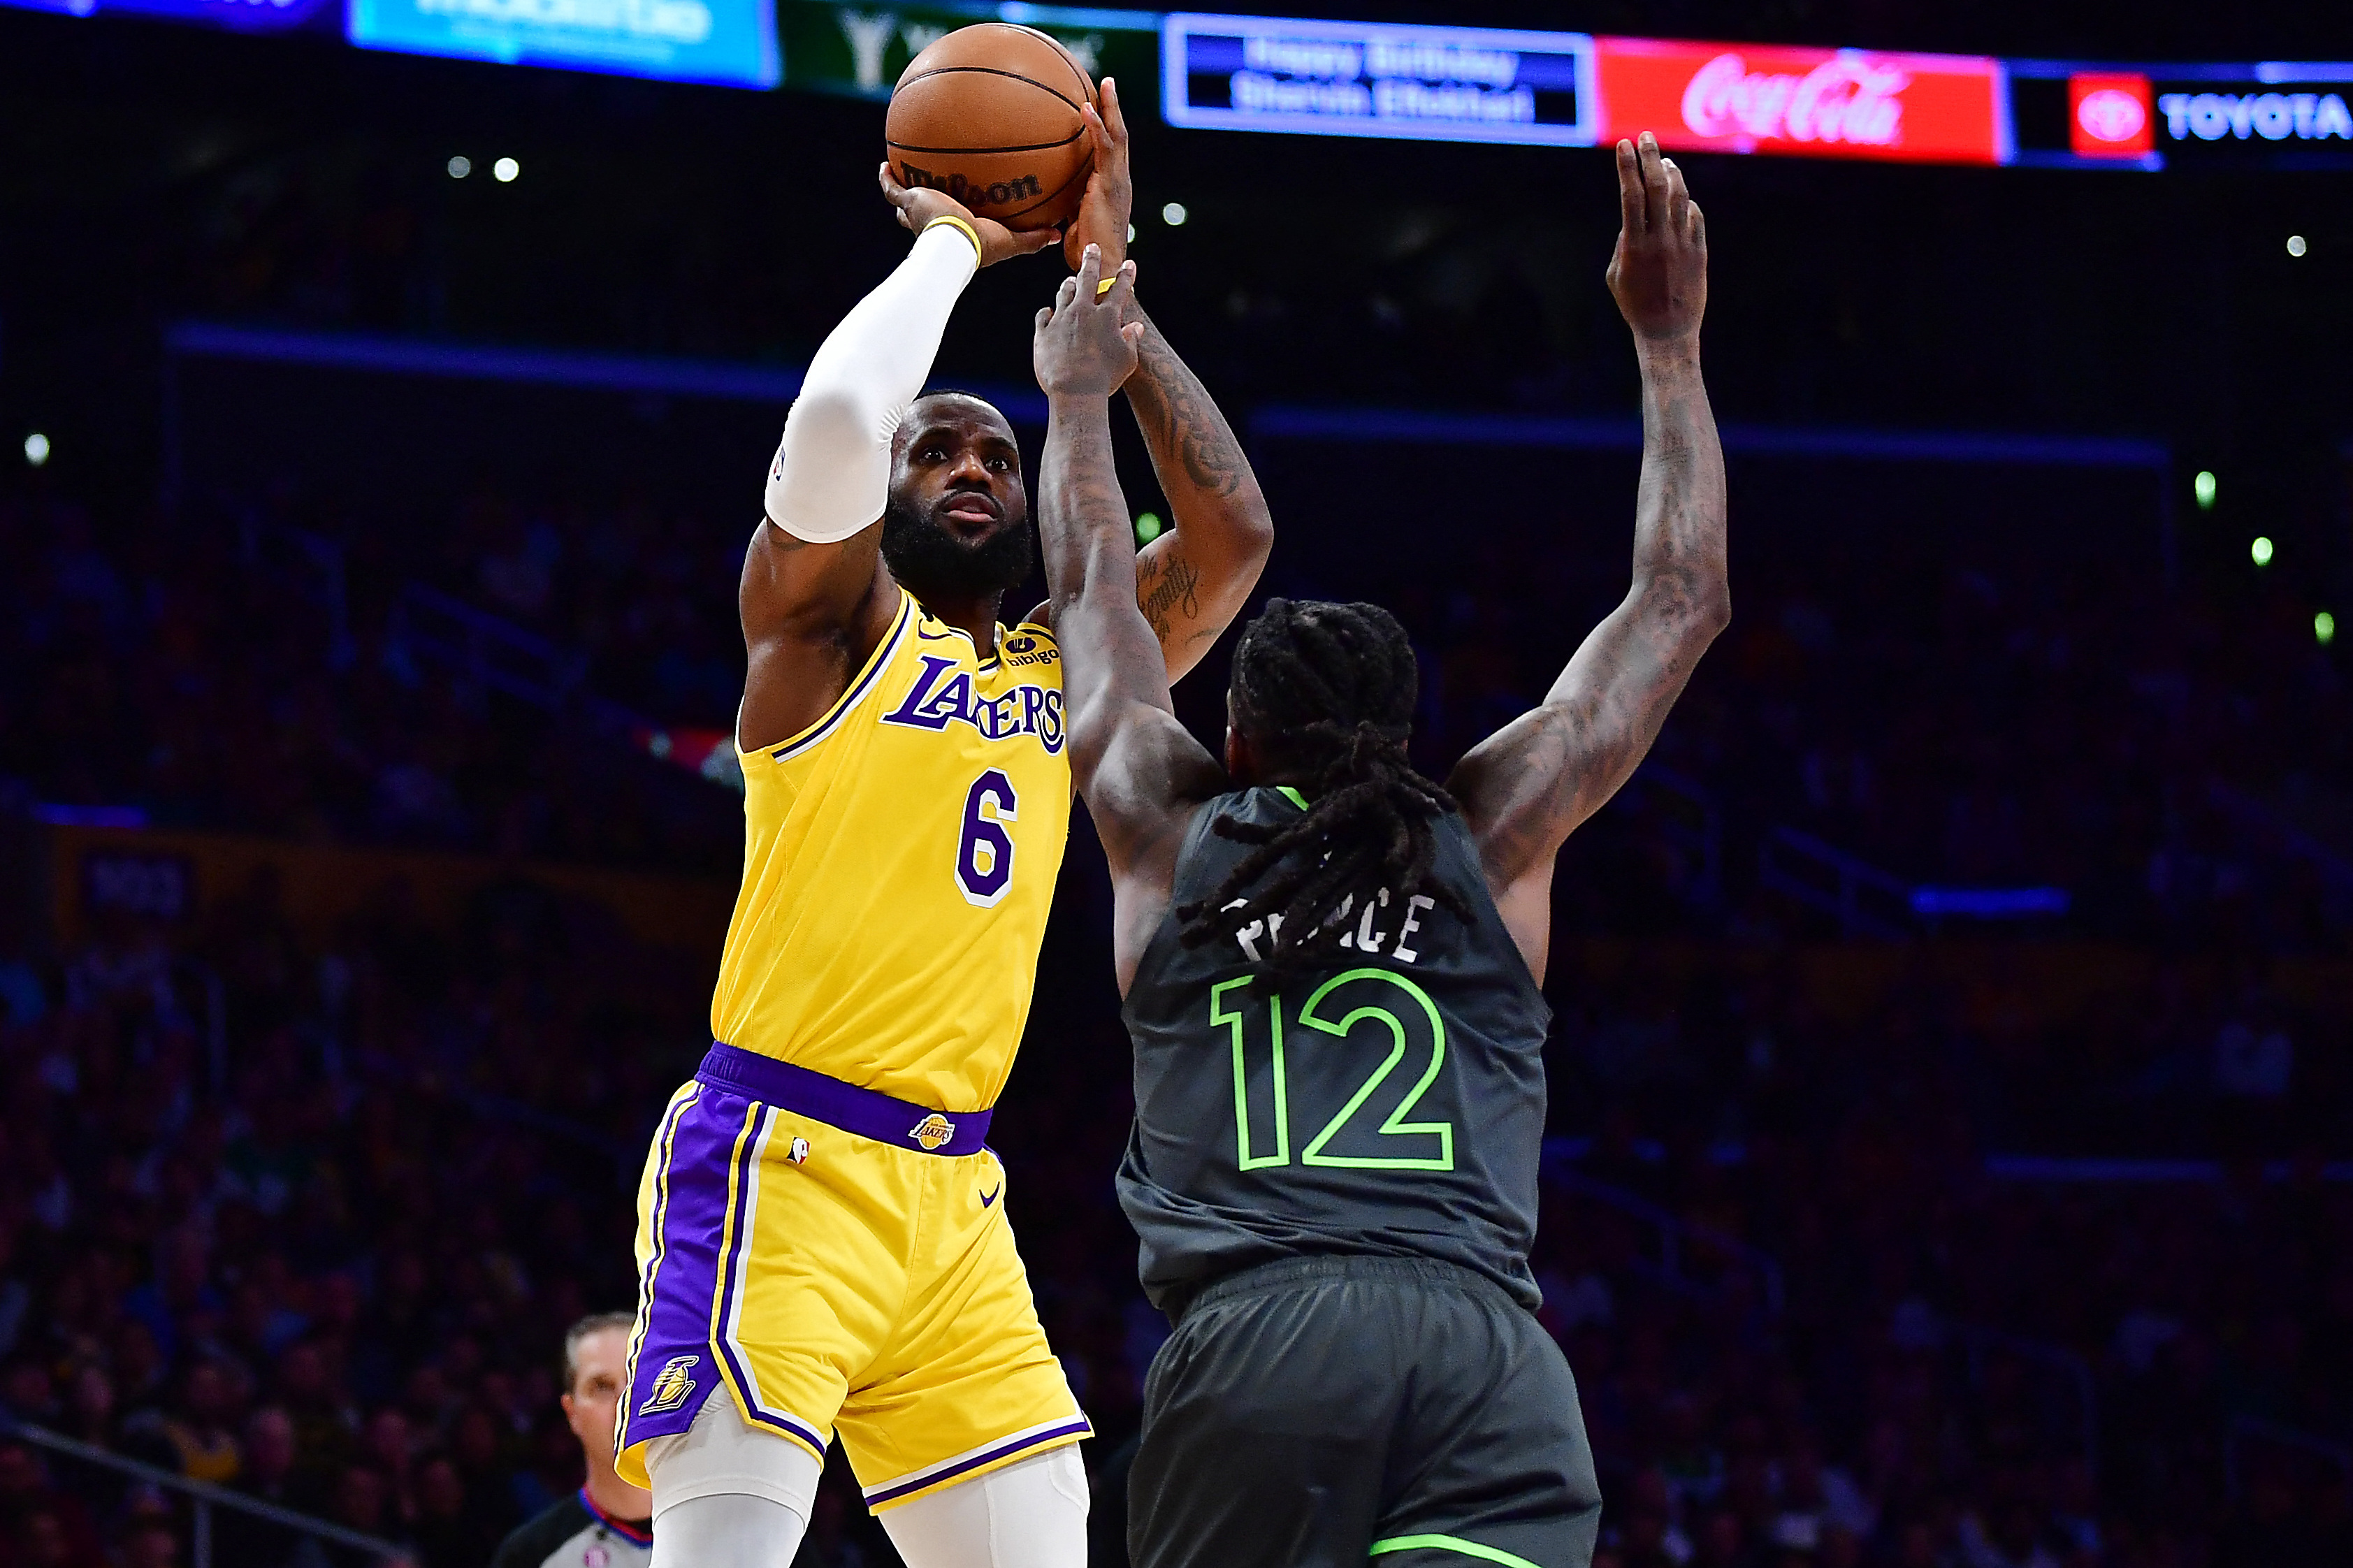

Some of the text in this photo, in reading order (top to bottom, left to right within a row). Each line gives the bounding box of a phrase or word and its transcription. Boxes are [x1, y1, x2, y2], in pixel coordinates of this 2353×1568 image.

[2158, 92, 2353, 140] TOYOTA
[1006, 648, 1059, 667] bibigo
[954, 766, 1018, 908] 6
[1210, 967, 1454, 1171] 12
[911, 1121, 953, 1143] LAKERS
